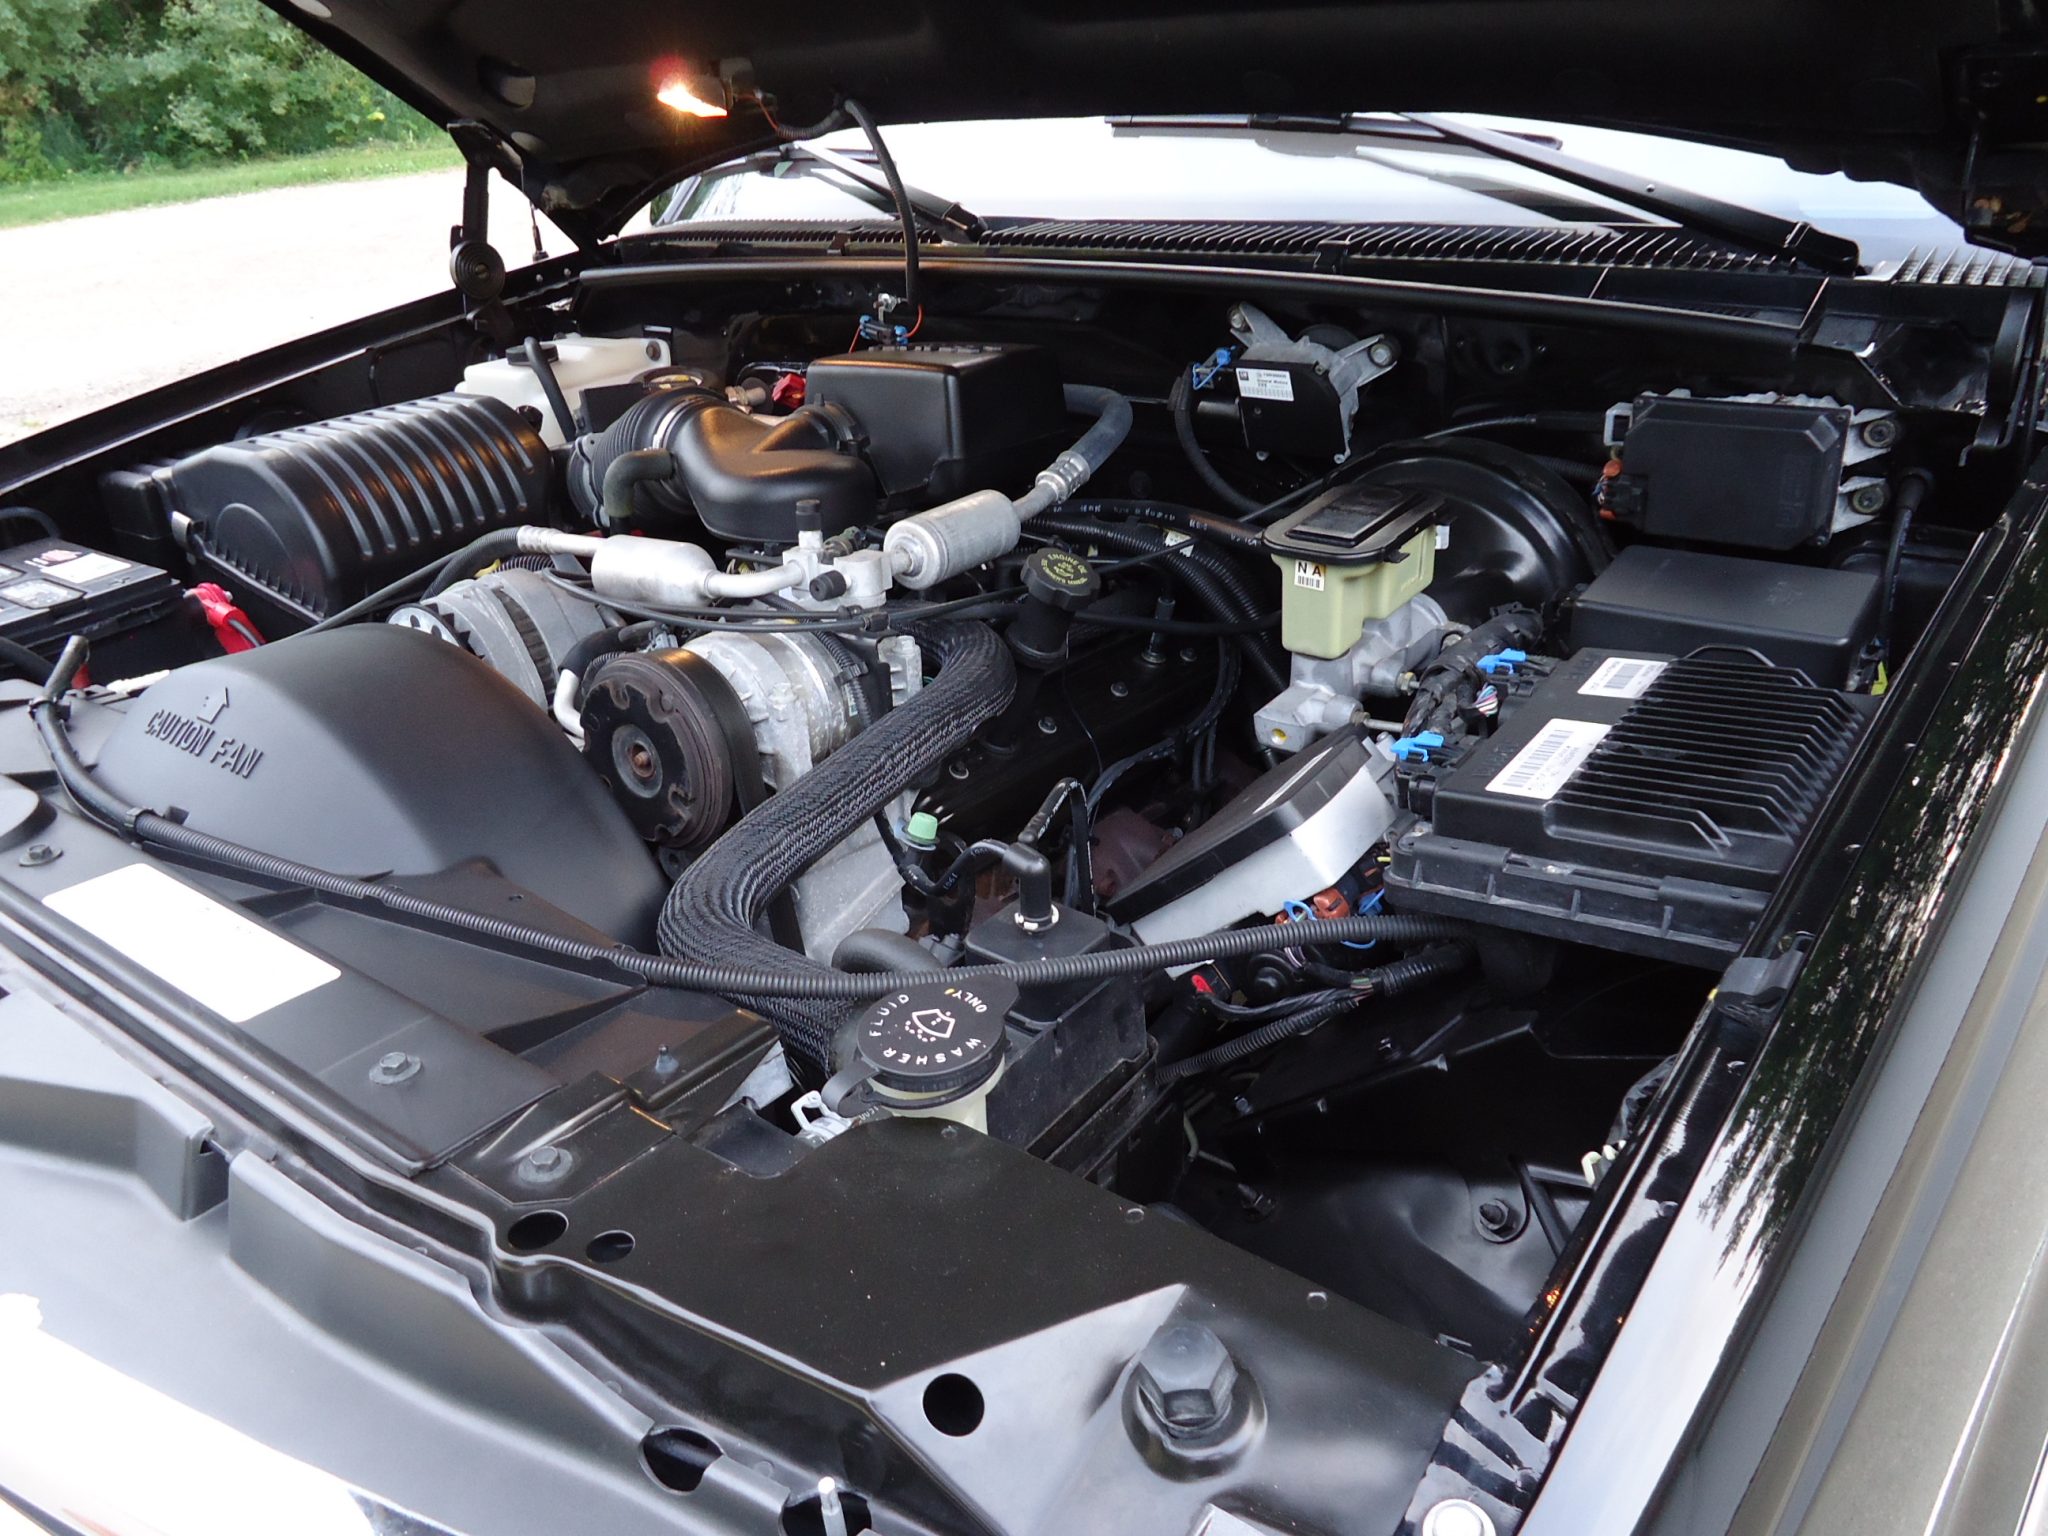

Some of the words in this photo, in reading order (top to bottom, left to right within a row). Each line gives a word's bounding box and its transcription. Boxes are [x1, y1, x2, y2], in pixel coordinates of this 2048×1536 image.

[144, 709, 216, 758] CAUTION
[210, 738, 264, 780] FAN
[869, 994, 910, 1037] FLUID
[952, 989, 988, 1013] ONLY
[883, 1037, 982, 1066] WASHER
